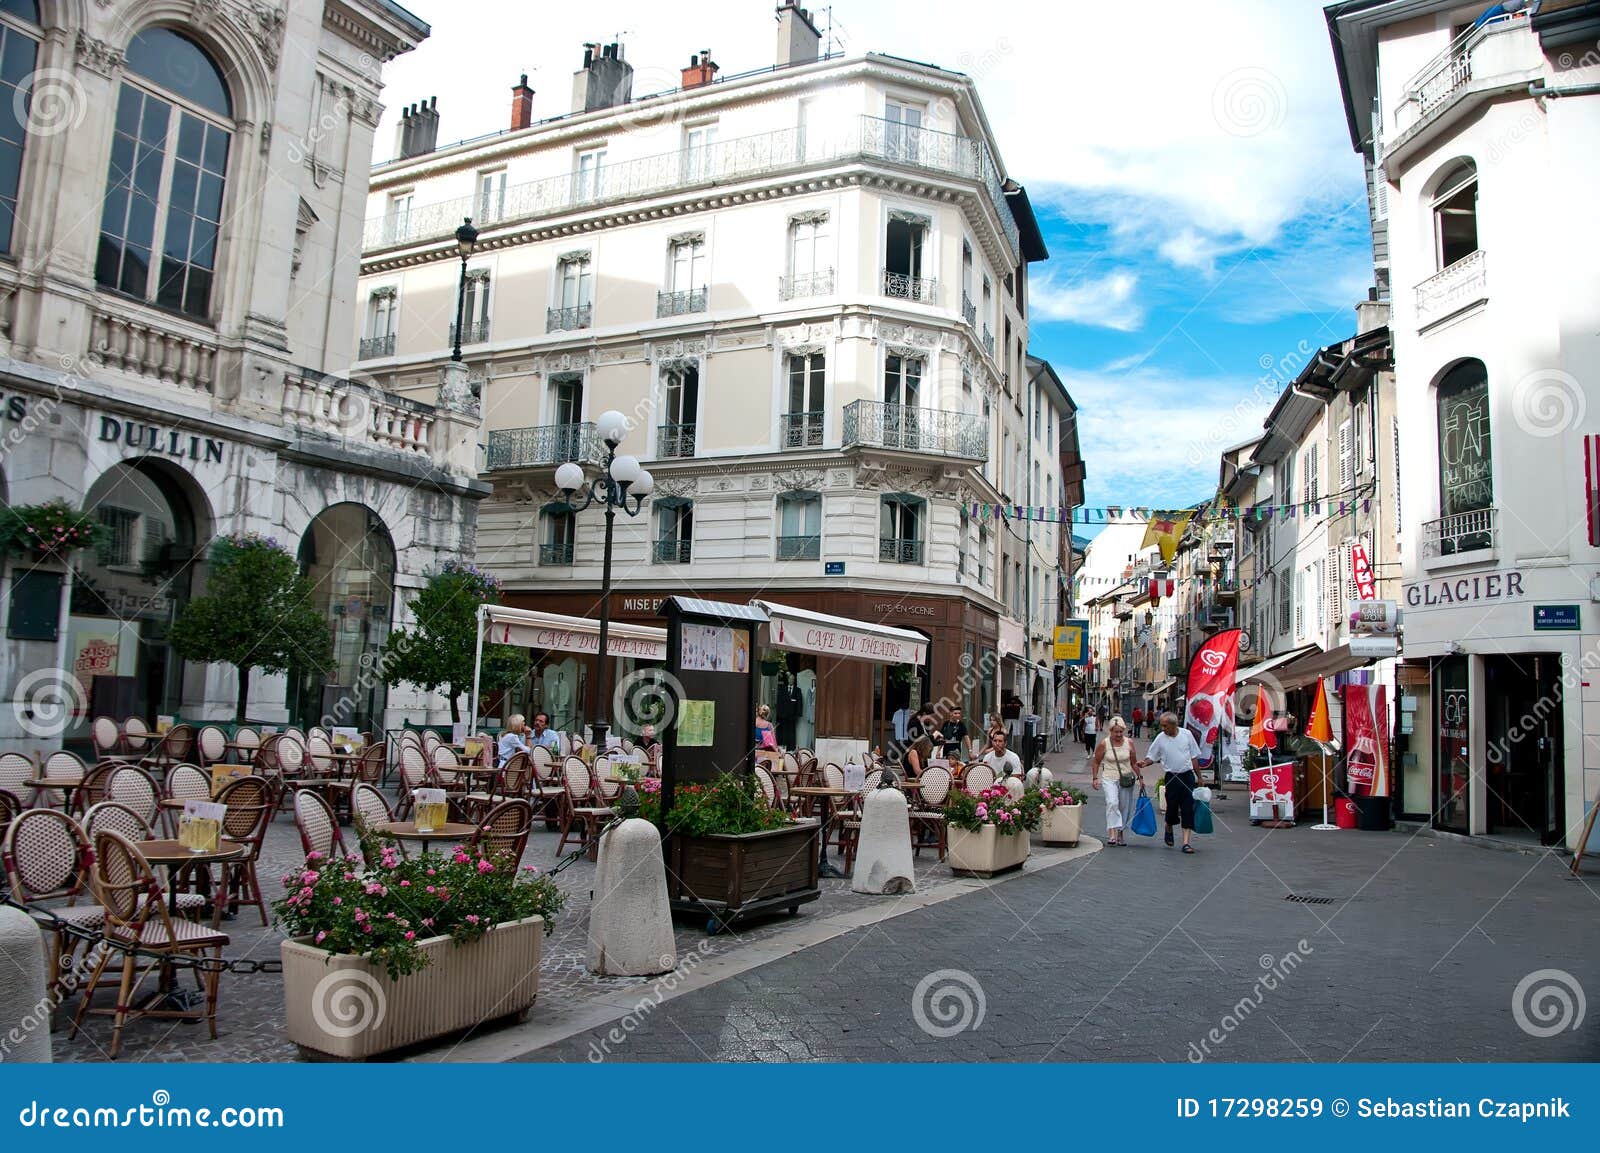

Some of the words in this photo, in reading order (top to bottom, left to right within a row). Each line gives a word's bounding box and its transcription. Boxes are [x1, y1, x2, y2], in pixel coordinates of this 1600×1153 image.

[98, 415, 224, 464] DULLIN
[1407, 572, 1524, 606] GLACIER
[624, 599, 650, 610] MISE
[839, 634, 854, 651] DU
[80, 646, 117, 660] SAISON
